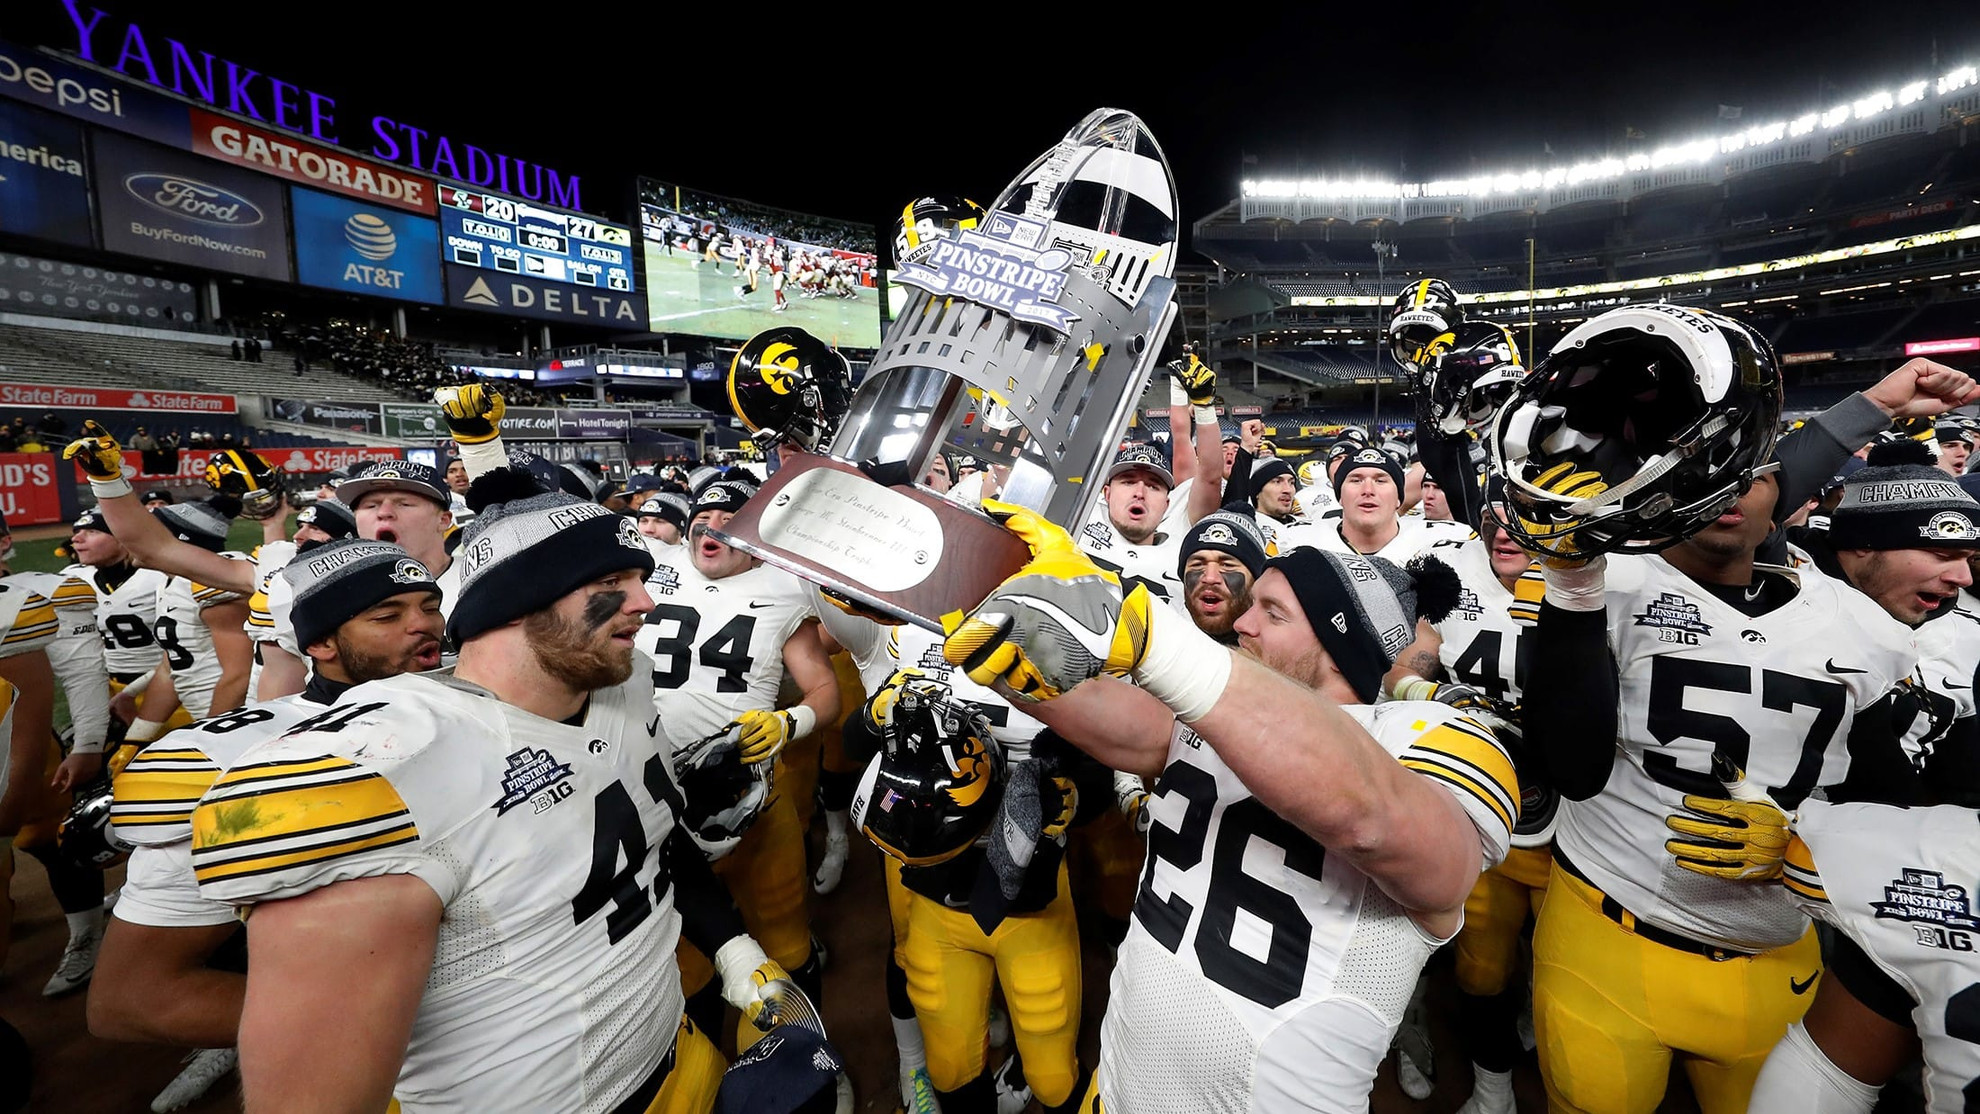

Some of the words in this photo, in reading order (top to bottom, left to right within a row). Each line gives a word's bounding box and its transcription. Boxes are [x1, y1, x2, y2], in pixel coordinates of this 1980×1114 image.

[62, 0, 338, 145] YANKEE
[371, 115, 583, 211] STADIUM
[211, 126, 424, 206] GATORADE
[155, 180, 240, 223] Ford
[486, 200, 514, 221] 20
[131, 222, 267, 260] BuyFordNow.com
[569, 219, 593, 239] 27
[448, 235, 483, 251] DOWN
[489, 244, 504, 254] TO
[504, 246, 522, 259] GO
[528, 234, 560, 251] 0:00
[343, 263, 404, 289] AT&T
[916, 271, 938, 285] NYC
[932, 242, 1061, 296] PINSTRIPE
[951, 272, 1016, 308] BOWL
[511, 283, 637, 322] DELTA
[313, 407, 374, 419] Panasonic
[498, 417, 556, 430] OTIRE.COM
[0, 463, 51, 487] D'S
[1661, 617, 1687, 627] BOWL
[644, 603, 757, 694] 34
[1643, 654, 1848, 812] 57
[506, 760, 556, 793] PINSTRIPE
[523, 774, 550, 794] BOWL
[1131, 758, 1327, 1011] 26
[1889, 891, 1965, 914] PINSTRIPE
[1905, 905, 1946, 921] BOWL
